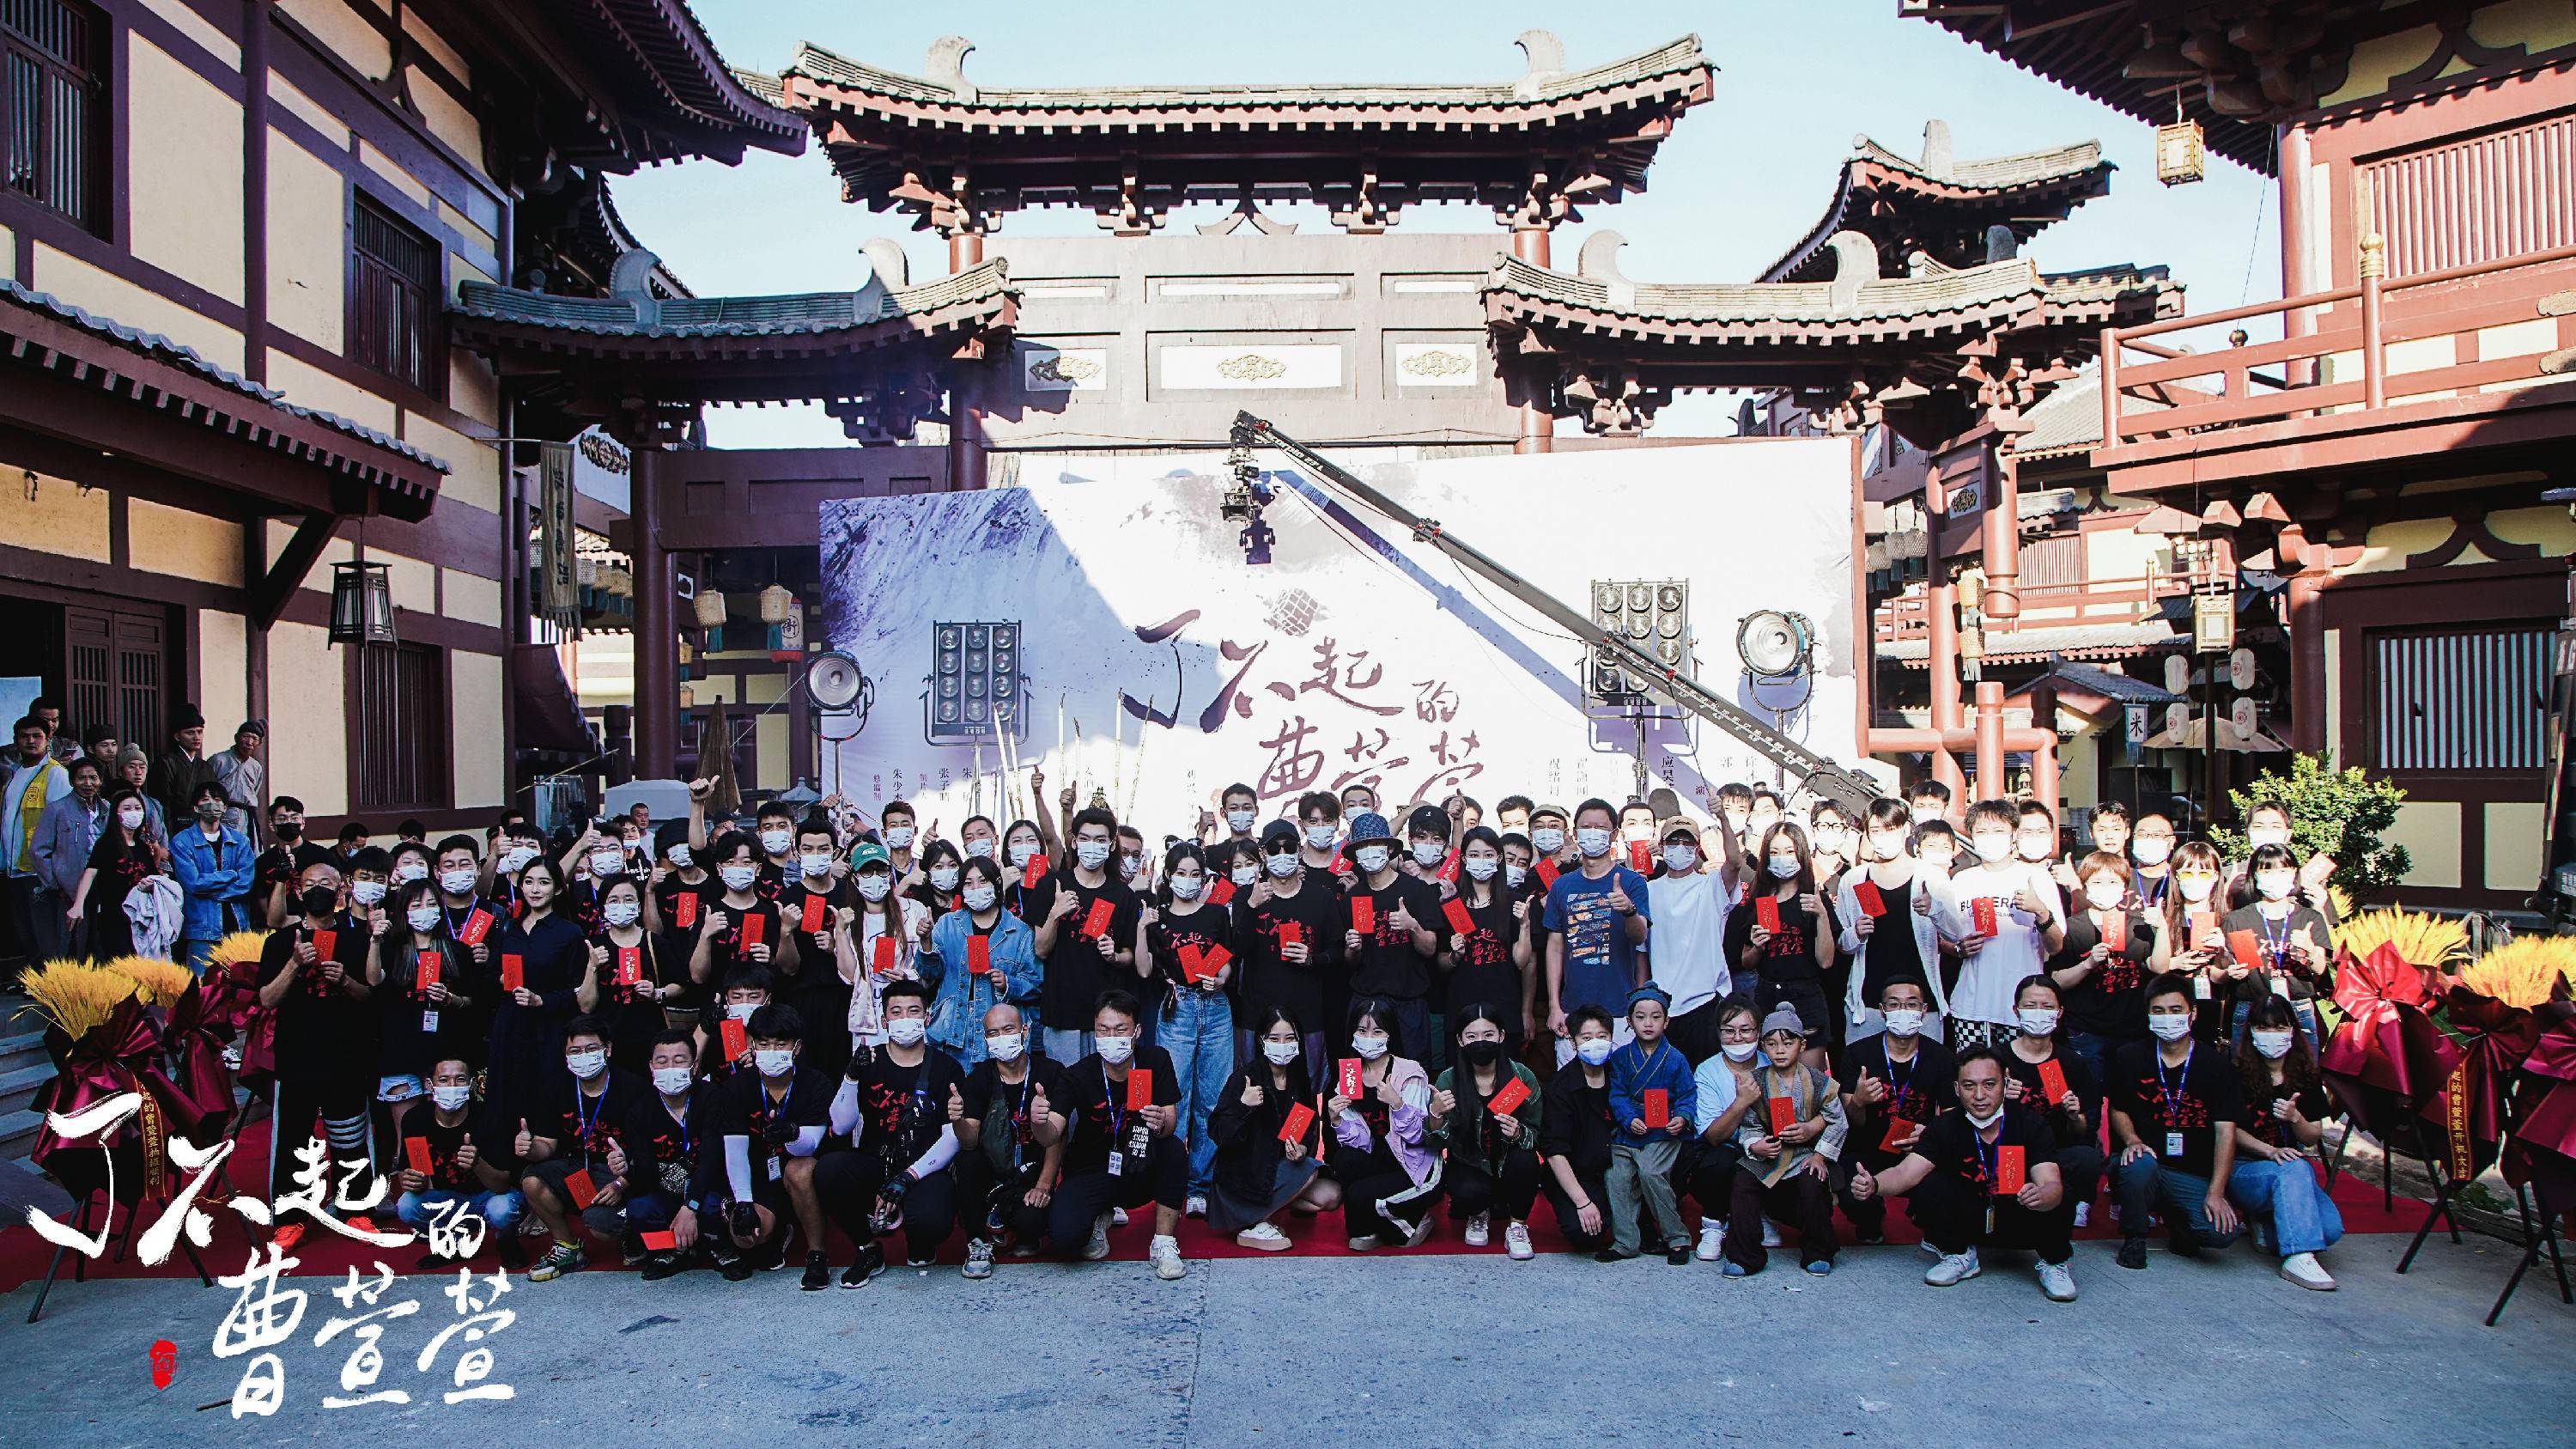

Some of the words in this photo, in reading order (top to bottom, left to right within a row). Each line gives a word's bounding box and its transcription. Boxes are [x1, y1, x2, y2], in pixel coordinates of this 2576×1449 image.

[1121, 609, 1460, 734] 了不起的
[2129, 712, 2143, 737] 米
[873, 774, 882, 801] 总监制
